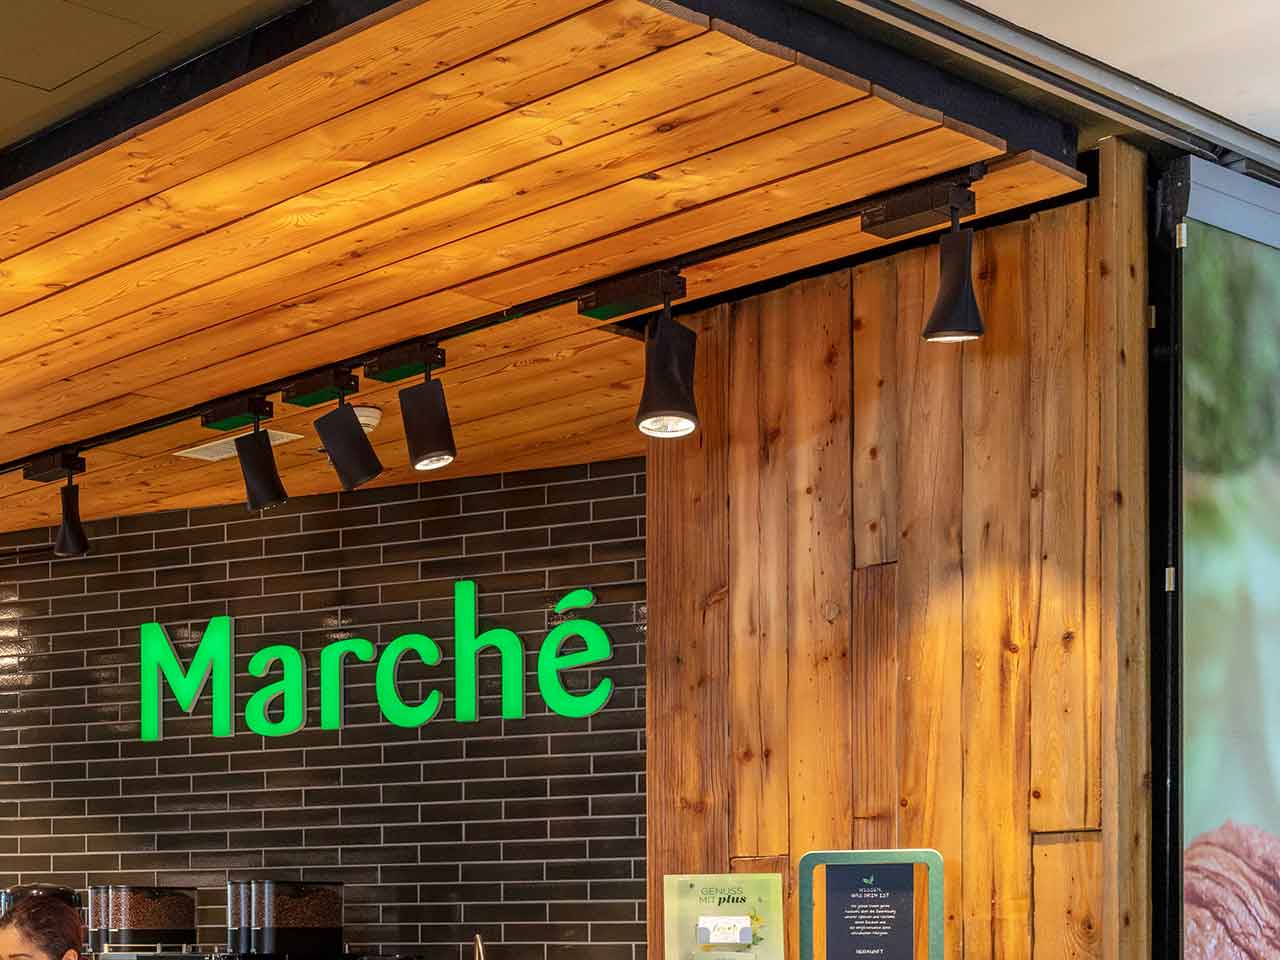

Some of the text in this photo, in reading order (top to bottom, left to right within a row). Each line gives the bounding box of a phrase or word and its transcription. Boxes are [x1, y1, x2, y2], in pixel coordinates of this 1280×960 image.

[140, 580, 614, 742] Marché
[701, 887, 743, 896] GENUSS
[699, 894, 747, 906] MIT plus
